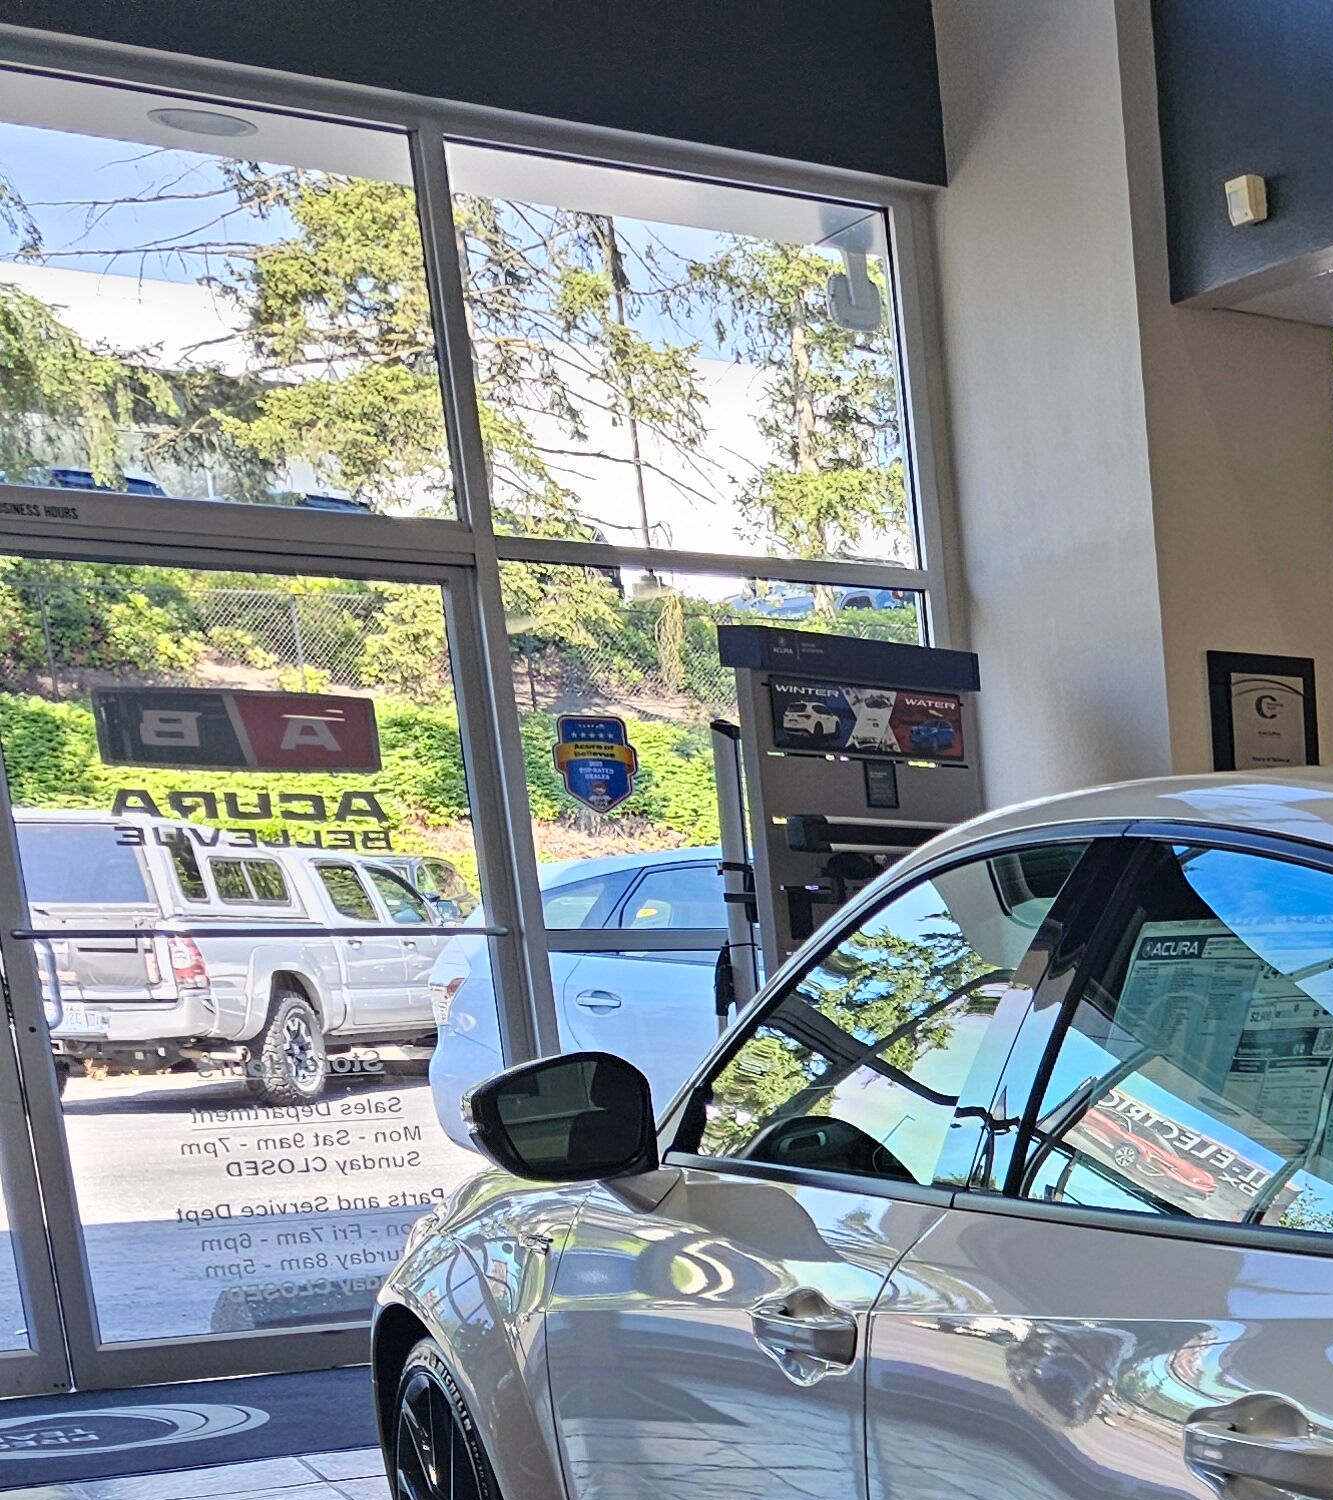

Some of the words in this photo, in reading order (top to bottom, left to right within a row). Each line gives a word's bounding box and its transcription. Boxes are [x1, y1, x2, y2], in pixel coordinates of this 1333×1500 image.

[775, 683, 839, 698] WINTER
[904, 698, 956, 709] WATER
[1151, 941, 1199, 957] ACURA
[435, 1360, 472, 1431] MICHELIN
[0, 1428, 97, 1443] TEA
